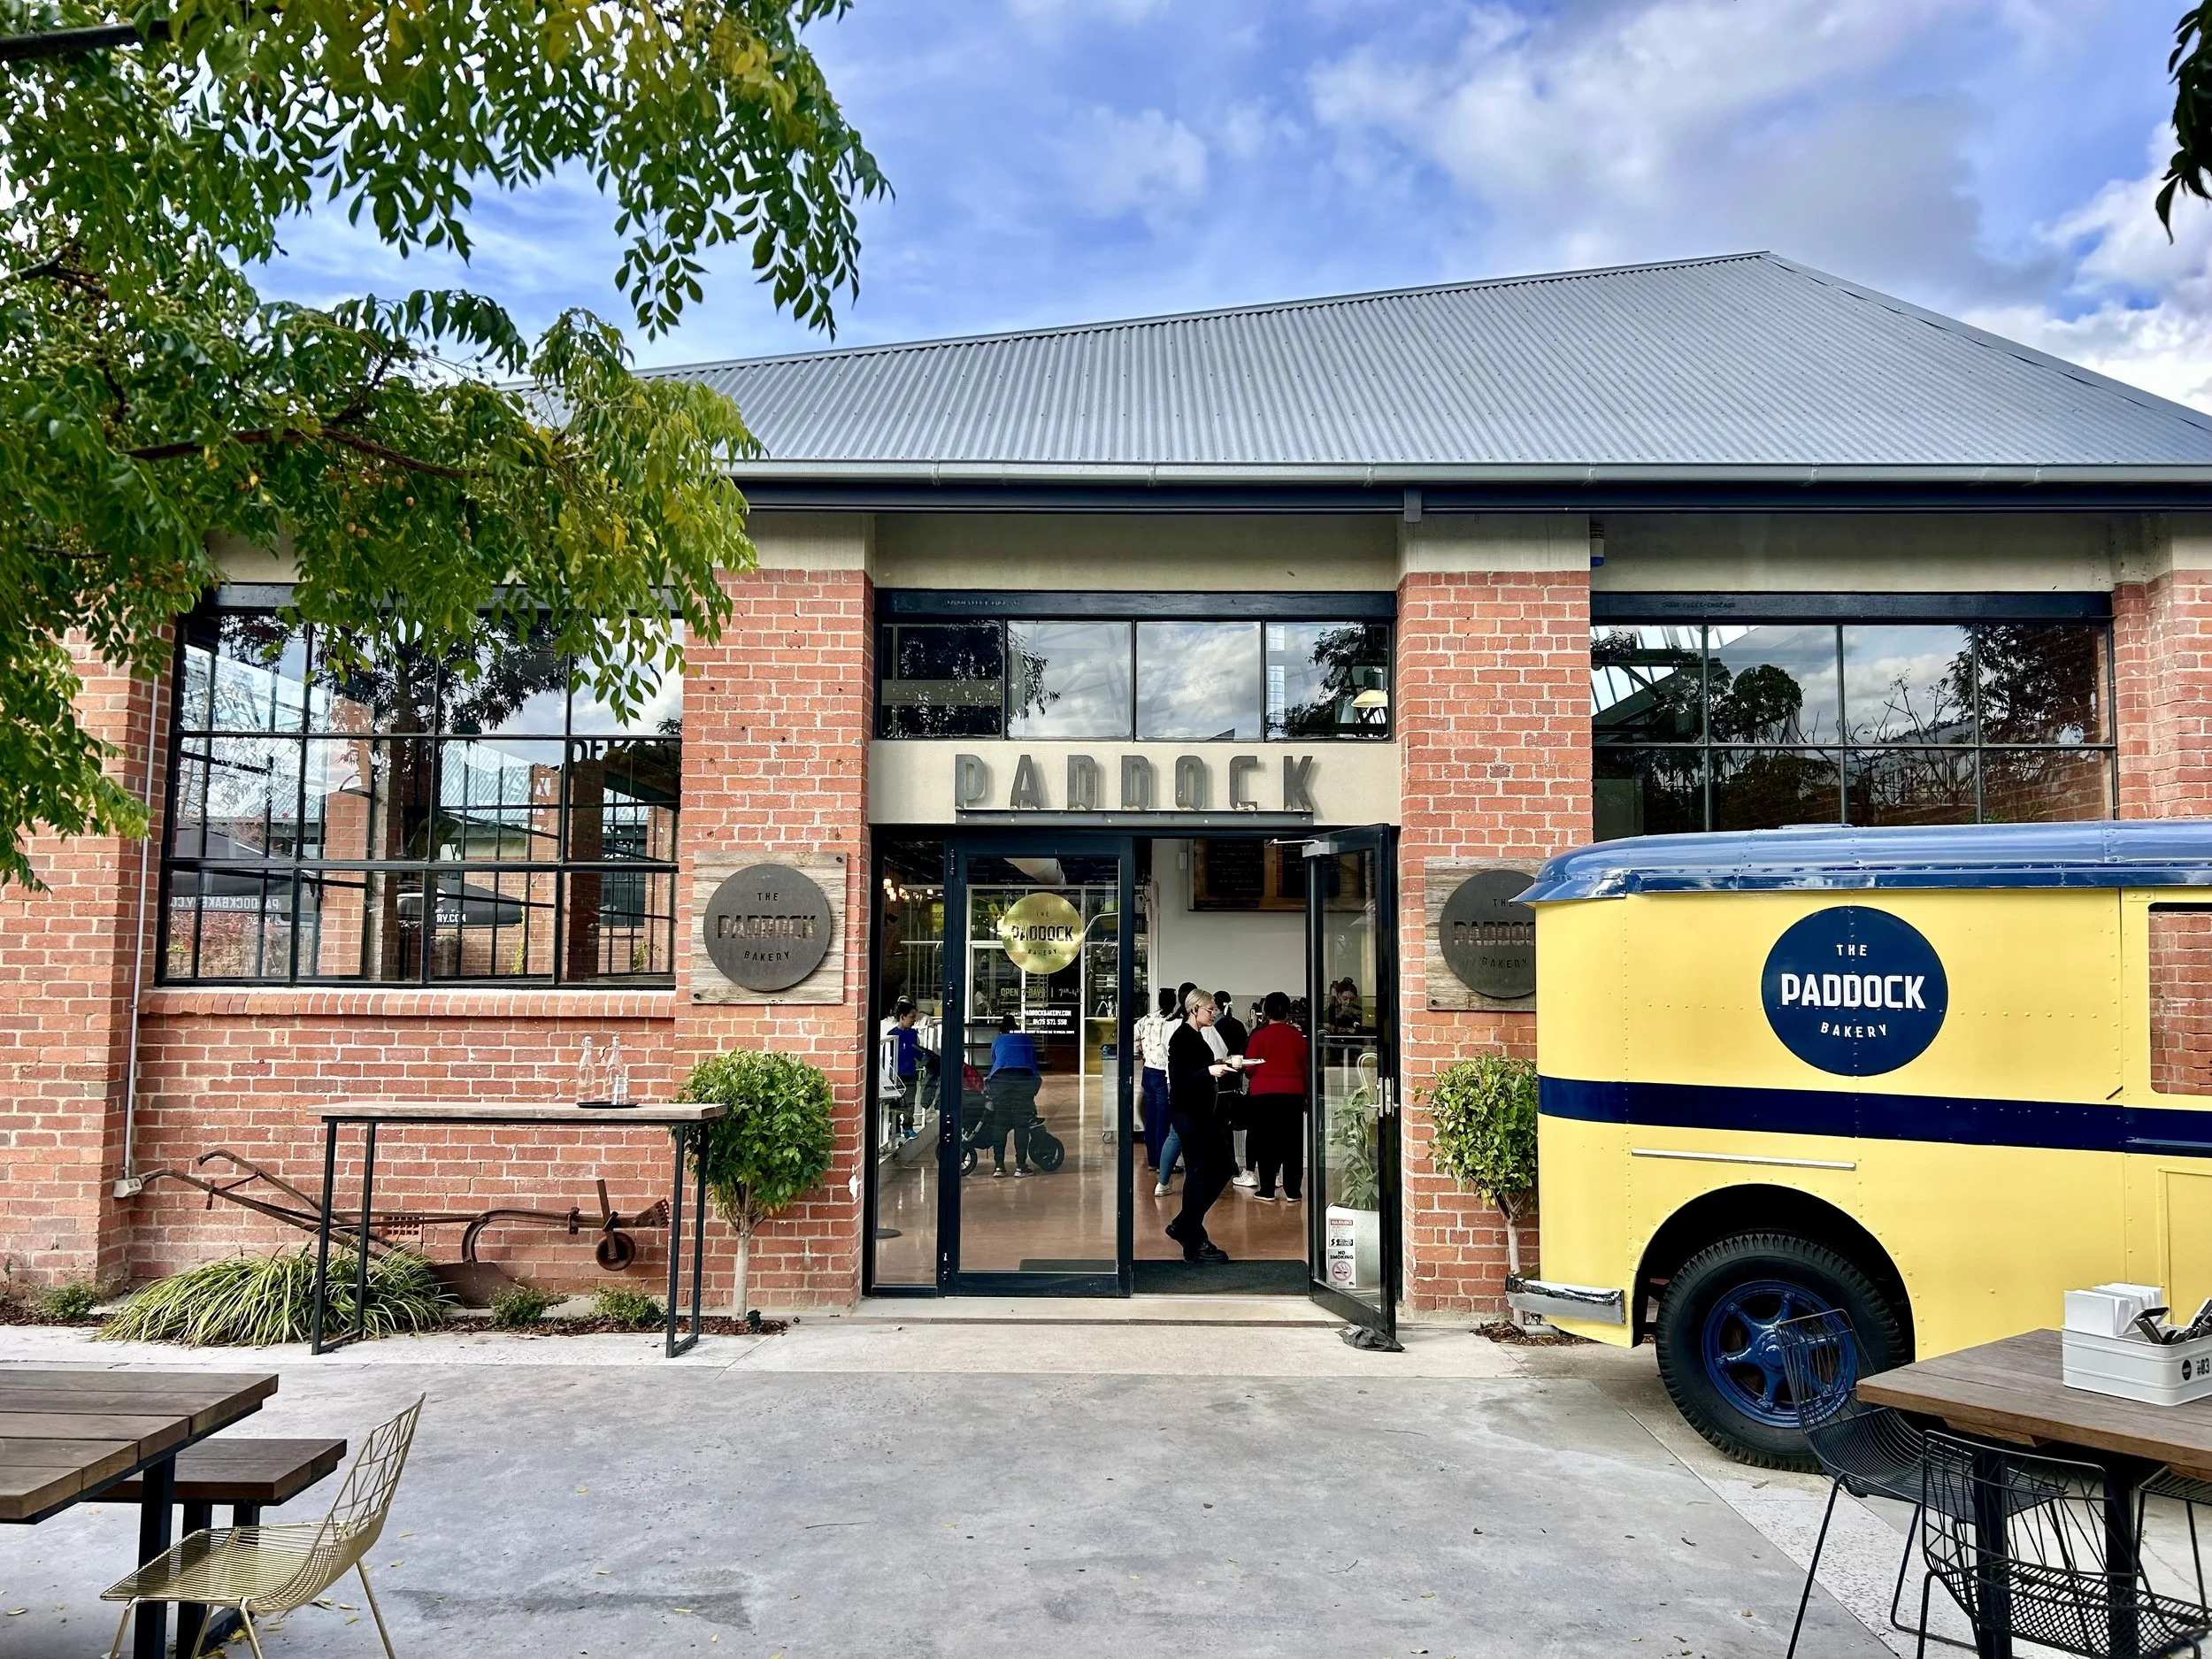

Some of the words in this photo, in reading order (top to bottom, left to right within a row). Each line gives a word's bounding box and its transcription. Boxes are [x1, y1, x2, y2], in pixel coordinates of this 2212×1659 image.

[955, 754, 1313, 811] PADDOCK
[757, 892, 779, 901] THE
[718, 914, 816, 939] PADDOCK
[1011, 926, 1074, 941] PADDOCK
[1454, 921, 1535, 945] PADDOC
[744, 950, 789, 962] BAKERY
[1836, 944, 1868, 956] THE
[1482, 956, 1527, 969] BAKERY
[1001, 987, 1019, 996] OPEN
[1028, 988, 1046, 997] DAYS
[1781, 973, 1926, 1009] PADDOCK
[1820, 1021, 1887, 1038] BAKERY
